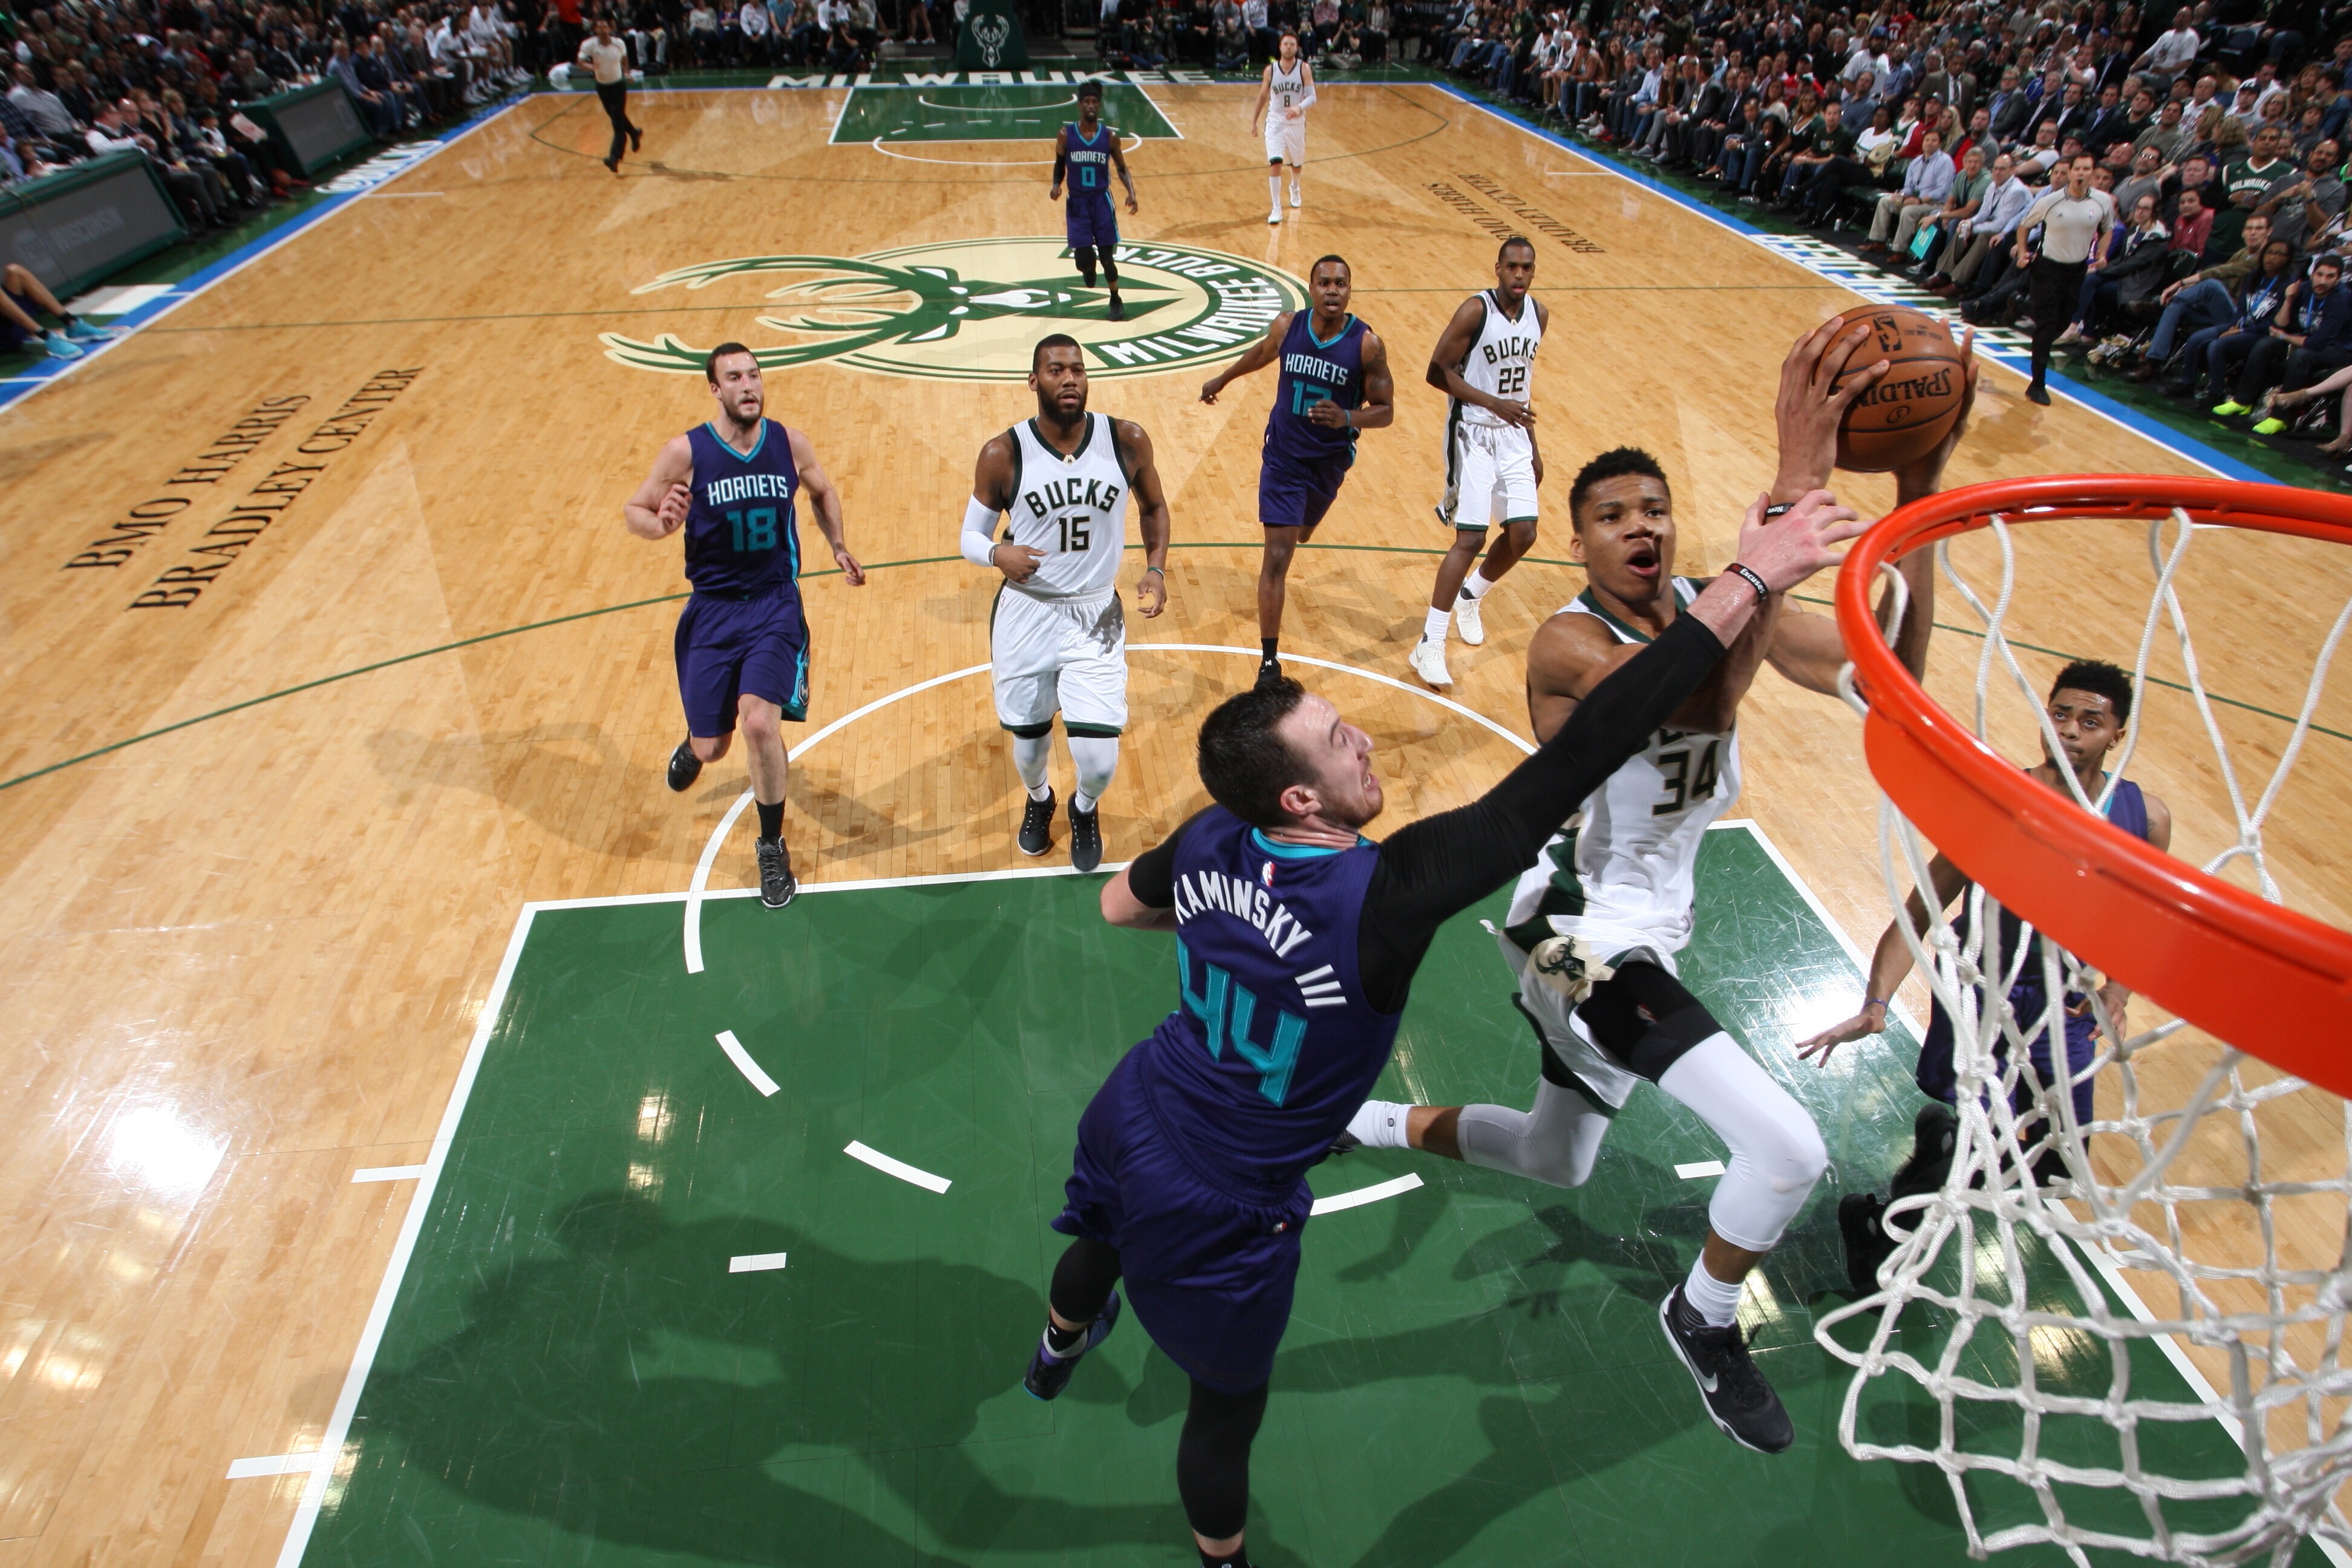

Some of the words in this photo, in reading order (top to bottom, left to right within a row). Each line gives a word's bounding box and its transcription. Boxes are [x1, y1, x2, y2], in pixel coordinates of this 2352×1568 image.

[767, 71, 1215, 88] MILWAUKEE
[1272, 82, 1302, 94] BUCKS
[1284, 95, 1290, 107] 8
[1070, 151, 1106, 165] HORNETS
[1082, 166, 1096, 187] 0
[1457, 174, 1526, 205] CENTER
[2229, 178, 2272, 192] MILWAUK
[1422, 182, 1491, 214] HARRIS
[1512, 209, 1607, 253] BRADLEY
[1069, 245, 1241, 278] BUCK
[1748, 234, 1881, 271] DEER
[1826, 273, 1947, 304] THE
[1099, 277, 1282, 364] MILWAUKEE
[1483, 336, 1538, 365] BUCKS
[1285, 353, 1348, 386] HORNETS
[1498, 366, 1526, 394] 22
[61, 497, 192, 572] BMO
[165, 394, 311, 486] HARRIS
[124, 462, 329, 612] BRADLEY
[298, 366, 425, 454] CENTER
[707, 474, 789, 506] HORNETS
[1024, 478, 1120, 519] BUCKS
[727, 507, 777, 552] 18
[1059, 516, 1090, 552] 15
[1740, 568, 1765, 593] Excuses
[1651, 739, 1720, 817] 34
[1174, 870, 1313, 959] KAMINSKY
[1295, 964, 1348, 1008] III
[1177, 933, 1307, 1108] 44
